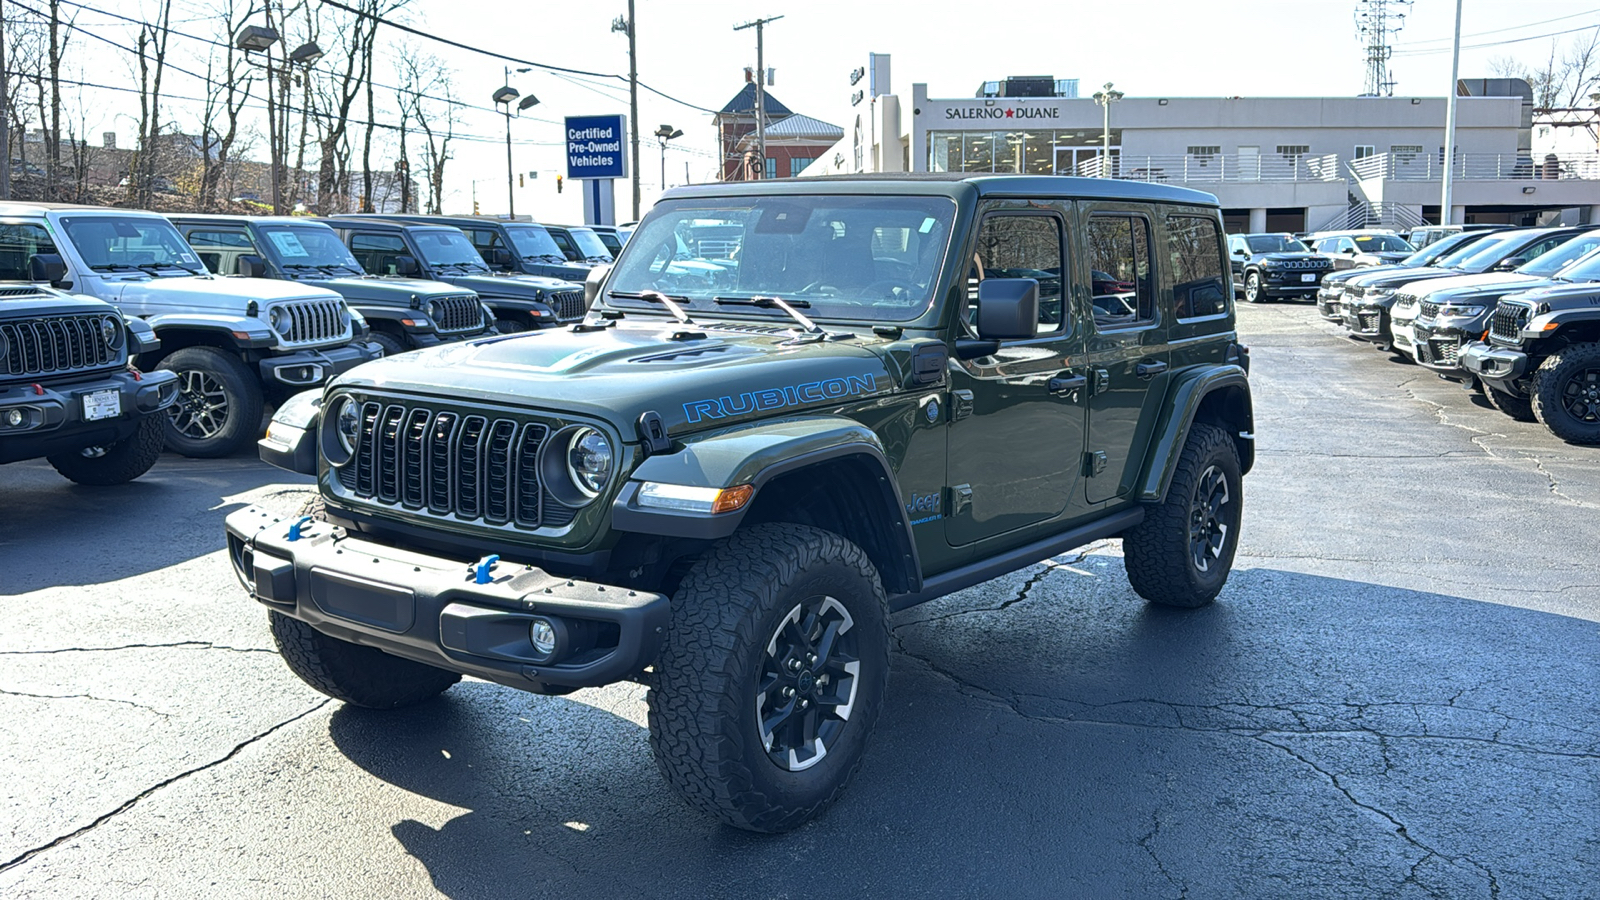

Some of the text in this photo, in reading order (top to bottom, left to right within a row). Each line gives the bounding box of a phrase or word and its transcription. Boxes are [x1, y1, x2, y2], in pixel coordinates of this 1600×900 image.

[945, 107, 1060, 119] SALERNO DUANE
[568, 127, 613, 139] Certified
[569, 140, 620, 153] Pre-Owned
[570, 155, 614, 167] Vehicles
[682, 372, 877, 424] RUBICON
[906, 493, 940, 513] Jeep
